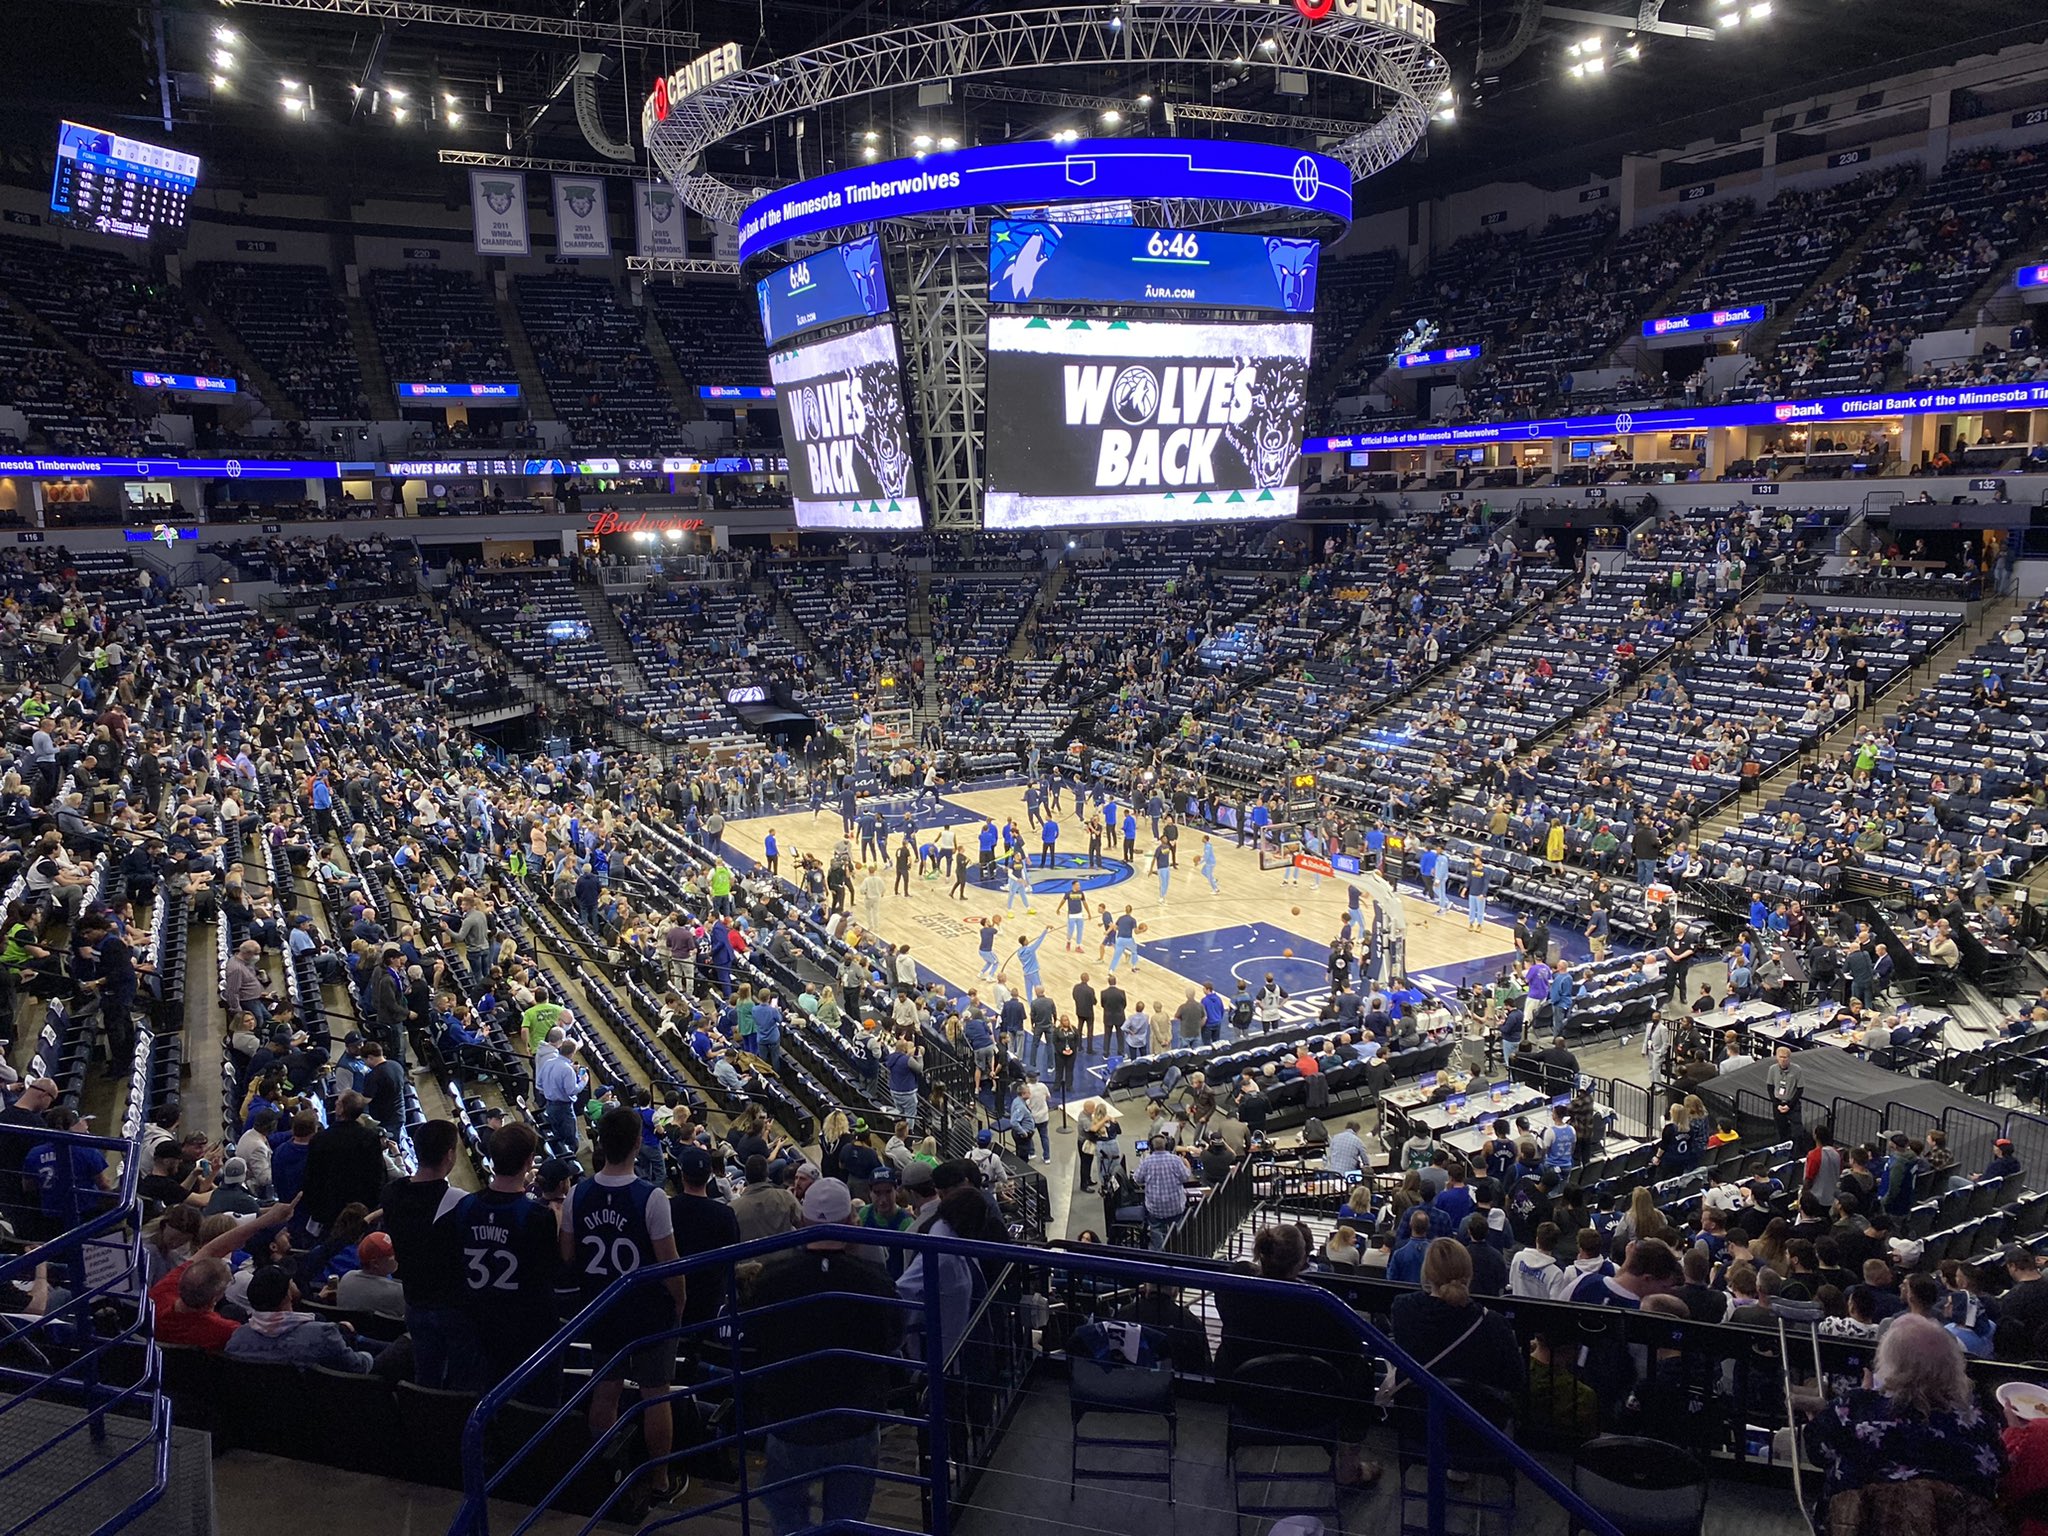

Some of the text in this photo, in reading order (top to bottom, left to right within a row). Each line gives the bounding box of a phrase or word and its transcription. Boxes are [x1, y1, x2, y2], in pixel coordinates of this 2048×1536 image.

[1338, 0, 1436, 43] CENTER
[667, 42, 741, 105] CENTER
[1839, 151, 1858, 165] 230
[760, 211, 767, 229] of
[767, 209, 781, 227] the
[783, 191, 841, 221] Minnesota
[845, 171, 960, 204] Timberwolves
[1688, 187, 1704, 198] 229
[481, 238, 523, 247] CHAMPIONS
[564, 240, 605, 249] CHAMPIONS
[1148, 231, 1198, 258] 6:46
[790, 261, 811, 289] 6:46
[1063, 365, 1256, 425] WOLVES
[1842, 400, 1883, 413] Official
[1886, 398, 1916, 410] Bank
[1918, 395, 1934, 407] of
[1935, 394, 1956, 407] the
[1959, 388, 2028, 405] Minnesota
[788, 377, 866, 441] WOLVES
[1361, 435, 1382, 445] Official
[1383, 435, 1399, 444] Bank
[1400, 434, 1406, 443] of
[1407, 434, 1418, 443] the
[1418, 431, 1451, 442] Minnesota
[1452, 428, 1499, 439] Timberwolves
[0, 460, 101, 471] nesota Timberwolves
[435, 463, 461, 474] BACK
[602, 460, 679, 471] 0 6:46 0
[807, 439, 860, 494] BACK
[1095, 428, 1222, 486] BACK
[1758, 485, 1772, 494] 131
[1978, 480, 1996, 490] 132
[588, 511, 704, 535] Budweiser
[912, 916, 959, 939] CENTER
[930, 912, 978, 935] TARGET
[1677, 1140, 1688, 1154] 0
[1500, 1158, 1505, 1172] 1
[583, 1208, 627, 1232] OKOGIE
[471, 1225, 509, 1244] TOWNS
[582, 1235, 640, 1277] 20
[464, 1248, 518, 1290] 32
